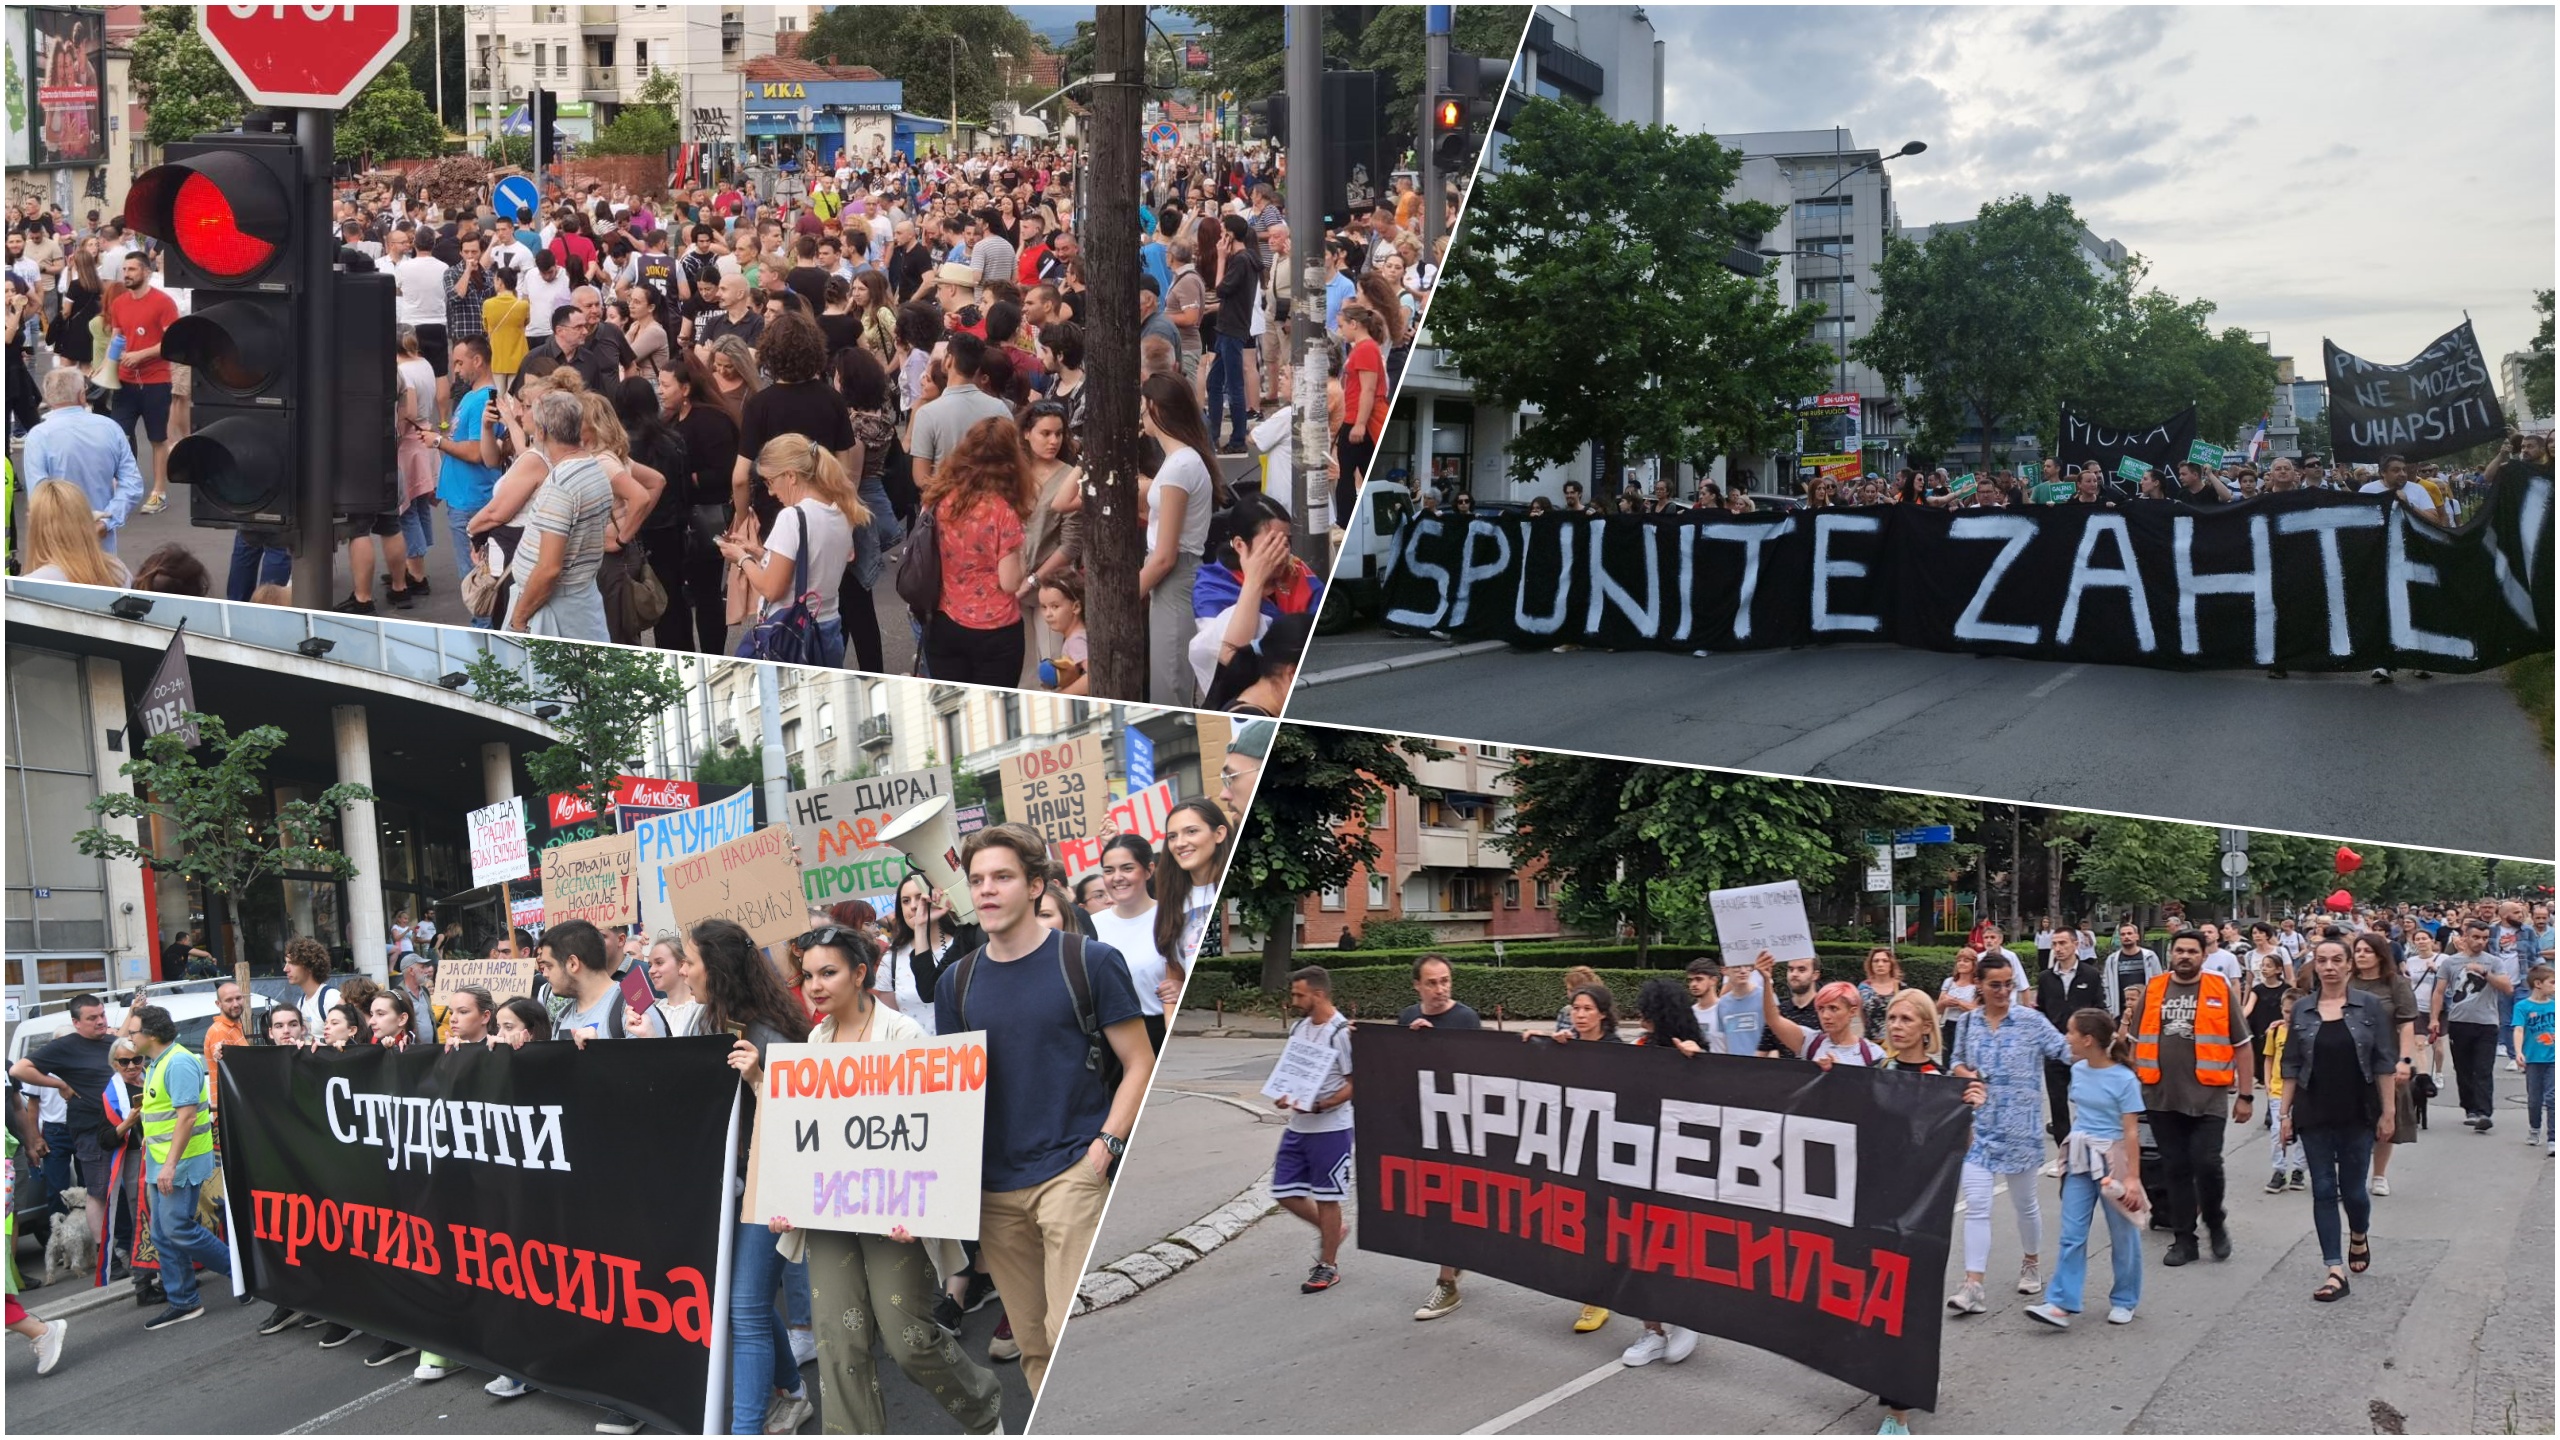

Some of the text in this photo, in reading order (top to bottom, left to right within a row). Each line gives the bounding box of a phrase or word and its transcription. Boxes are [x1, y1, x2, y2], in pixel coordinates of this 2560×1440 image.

[762, 83, 806, 99] ИКА
[2354, 347, 2487, 408] NE MOŽEŠ
[2350, 396, 2490, 447] UHAPSITI
[472, 800, 517, 828] ХОЋУ ДА
[637, 790, 754, 863] РАЧУНАЈТЕ
[795, 793, 833, 826] НЕ
[1026, 794, 1085, 826] НАШУ
[477, 819, 517, 847] ГРАДИМ
[1043, 816, 1087, 844] ЕЦУ
[546, 851, 611, 879] Загрљаји
[674, 856, 711, 890] СТОП
[720, 830, 781, 872] НАСИЉУ
[37, 888, 48, 898] 12
[555, 871, 616, 899] бесплатни
[440, 978, 450, 992] И
[482, 977, 527, 993] РАЗУМЕМ
[446, 961, 518, 976] ЈА САМ НАРОД
[770, 1043, 987, 1099] ПОЛОЖИЋЕМО
[325, 1076, 572, 1174] Студенти
[795, 1112, 929, 1152] И ОВАЈ
[1418, 1069, 1858, 1228] КРАЉЕВО
[813, 1167, 938, 1218] ИСПИТ
[1379, 1155, 1911, 1338] ПРОТИВ НАСИЉА
[250, 1188, 712, 1348] против насиља
